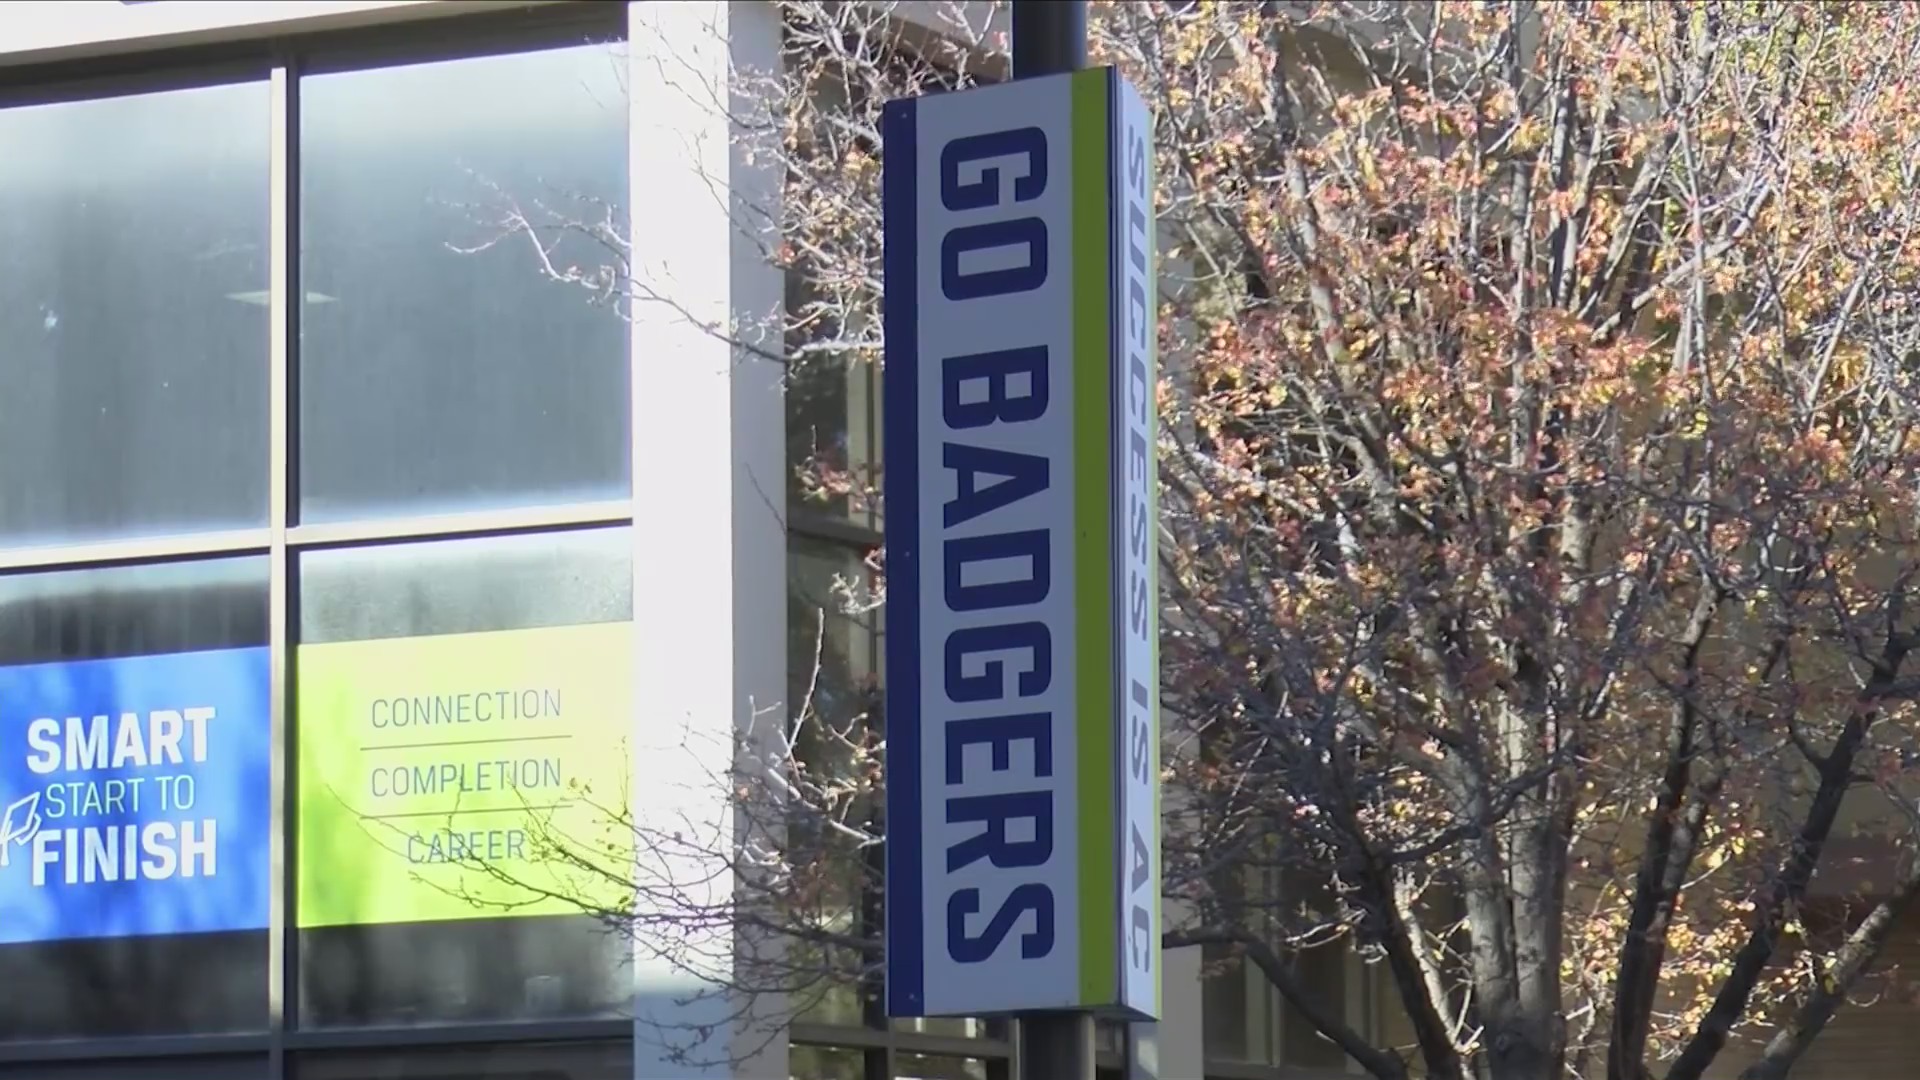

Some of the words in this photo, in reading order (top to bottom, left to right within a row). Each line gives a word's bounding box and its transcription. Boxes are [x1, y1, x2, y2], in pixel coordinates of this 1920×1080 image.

[940, 126, 1048, 301] GO
[1128, 123, 1148, 642] SUCCESS
[941, 344, 1055, 964] BADGERS
[26, 706, 216, 774] SMART
[371, 688, 561, 729] CONNECTION
[1130, 678, 1149, 787] IS
[45, 778, 145, 818] START
[155, 774, 195, 811] TO
[371, 757, 561, 798] COMPLETION
[32, 818, 217, 887] FINISH
[407, 829, 526, 864] CAREER
[1131, 819, 1150, 974] AC
